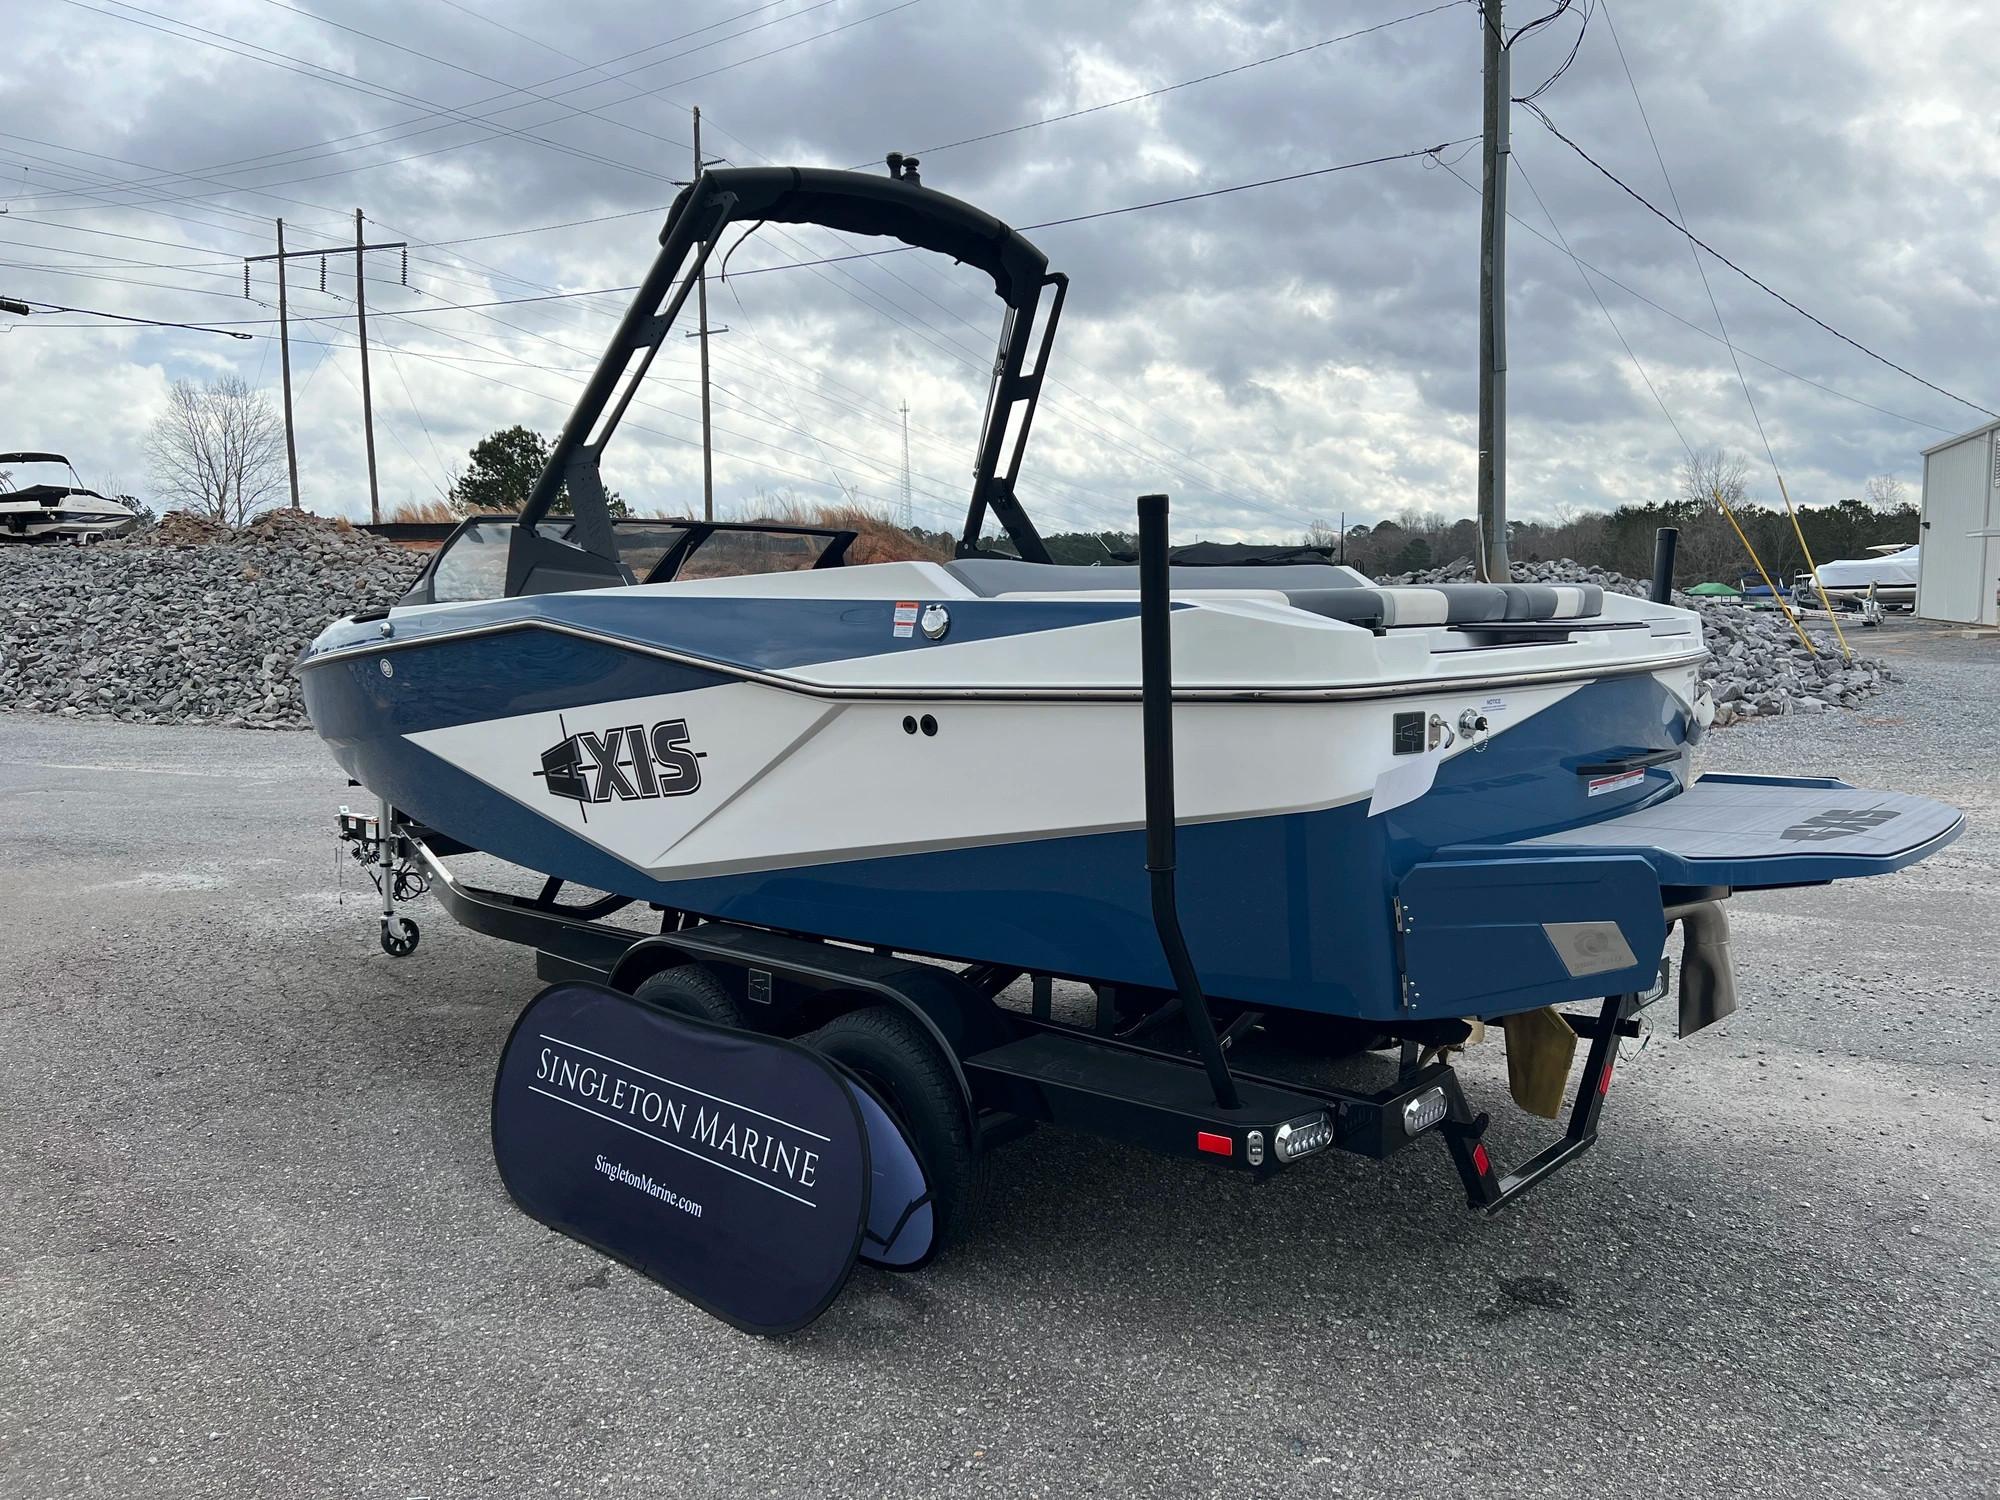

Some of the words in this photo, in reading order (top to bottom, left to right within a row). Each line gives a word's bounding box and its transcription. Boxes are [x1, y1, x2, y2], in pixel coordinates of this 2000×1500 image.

[539, 717, 702, 804] AXIS
[536, 1047, 687, 1134] SINGLETON
[690, 1105, 820, 1188] MARINE
[594, 1153, 703, 1218] SingletonMarine.com
